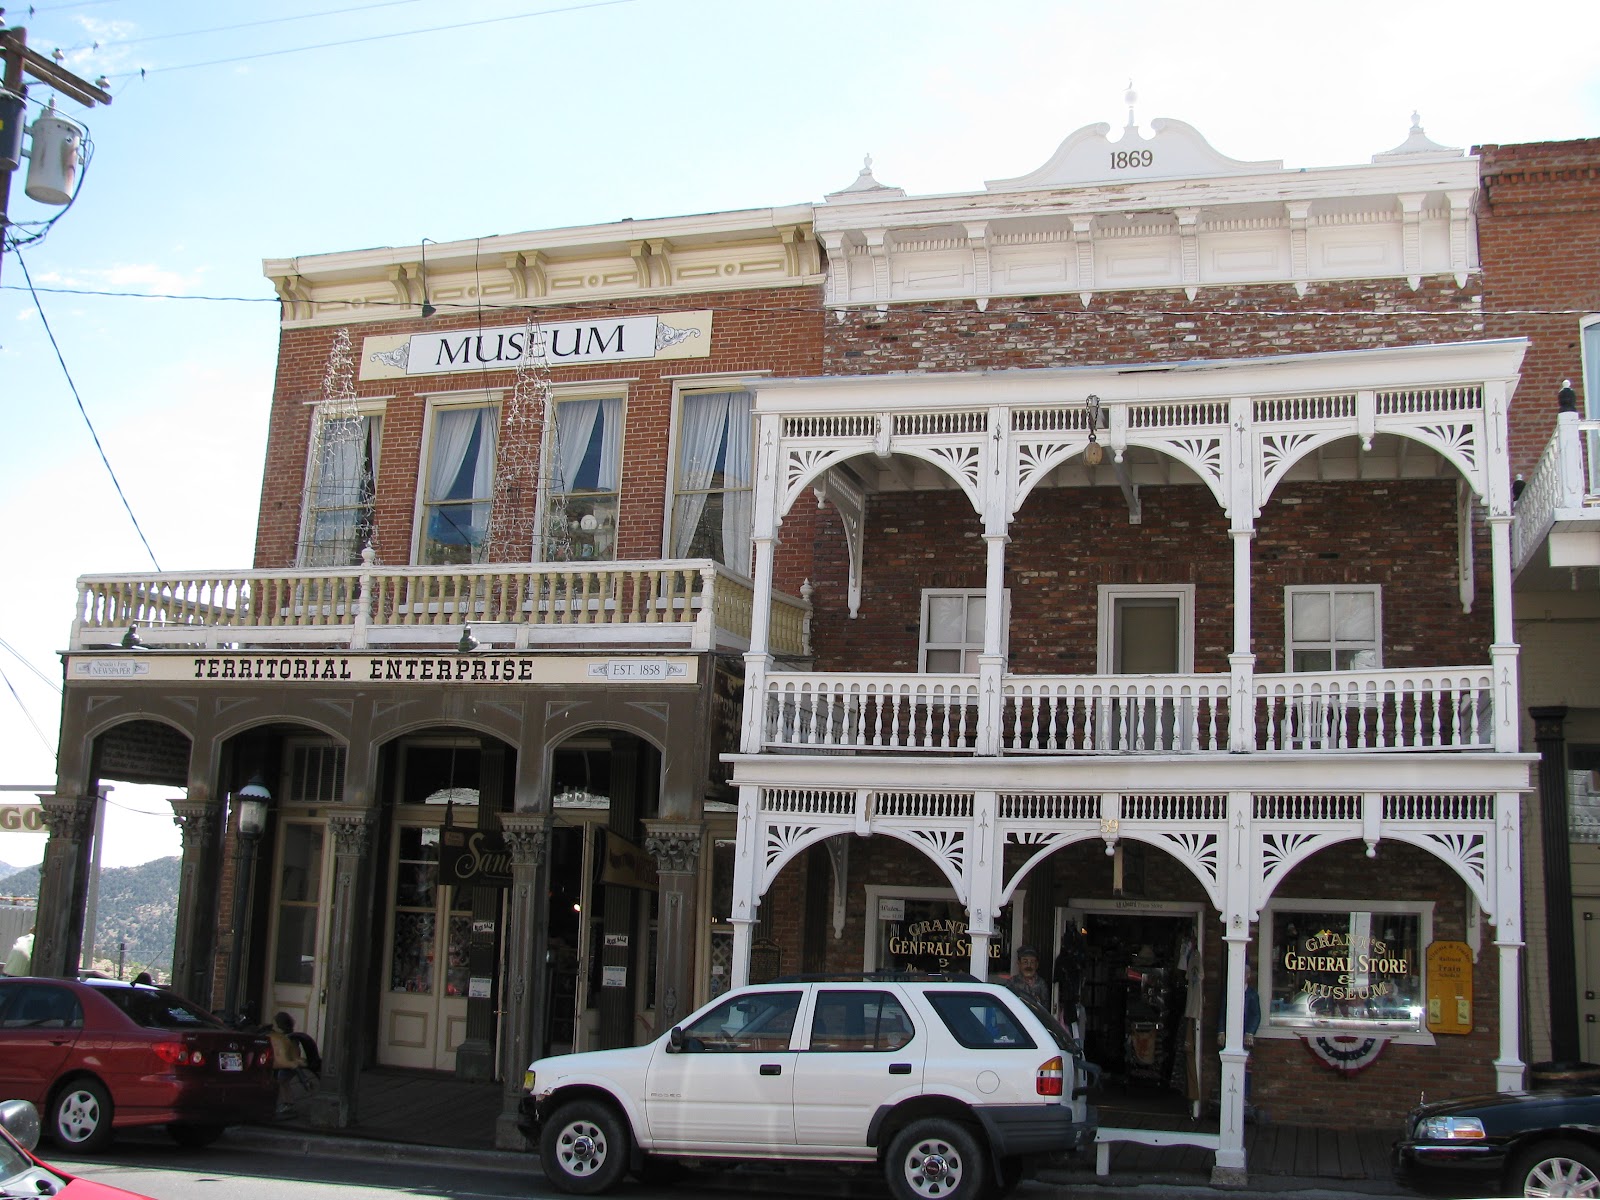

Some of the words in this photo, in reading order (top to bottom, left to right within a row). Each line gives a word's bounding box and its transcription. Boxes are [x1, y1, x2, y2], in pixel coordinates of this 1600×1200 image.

[1110, 149, 1153, 170] 1869
[435, 324, 626, 366] MUSEUM
[92, 667, 131, 675] NEWSPAPER
[194, 658, 351, 679] TERRITORIAL
[369, 658, 533, 681] ENTERPRISE
[613, 664, 635, 676] EST.
[639, 664, 661, 676] 1858
[0, 807, 50, 831] GO
[908, 919, 969, 937] GRANT
[889, 936, 953, 957] GENERAL
[956, 939, 1001, 958] STRE
[1305, 933, 1387, 955] GRANT'S
[1284, 951, 1355, 972] GENERAL
[1358, 954, 1408, 974] STORE
[1301, 979, 1389, 1000] MUSEUM
[1338, 974, 1356, 985] &
